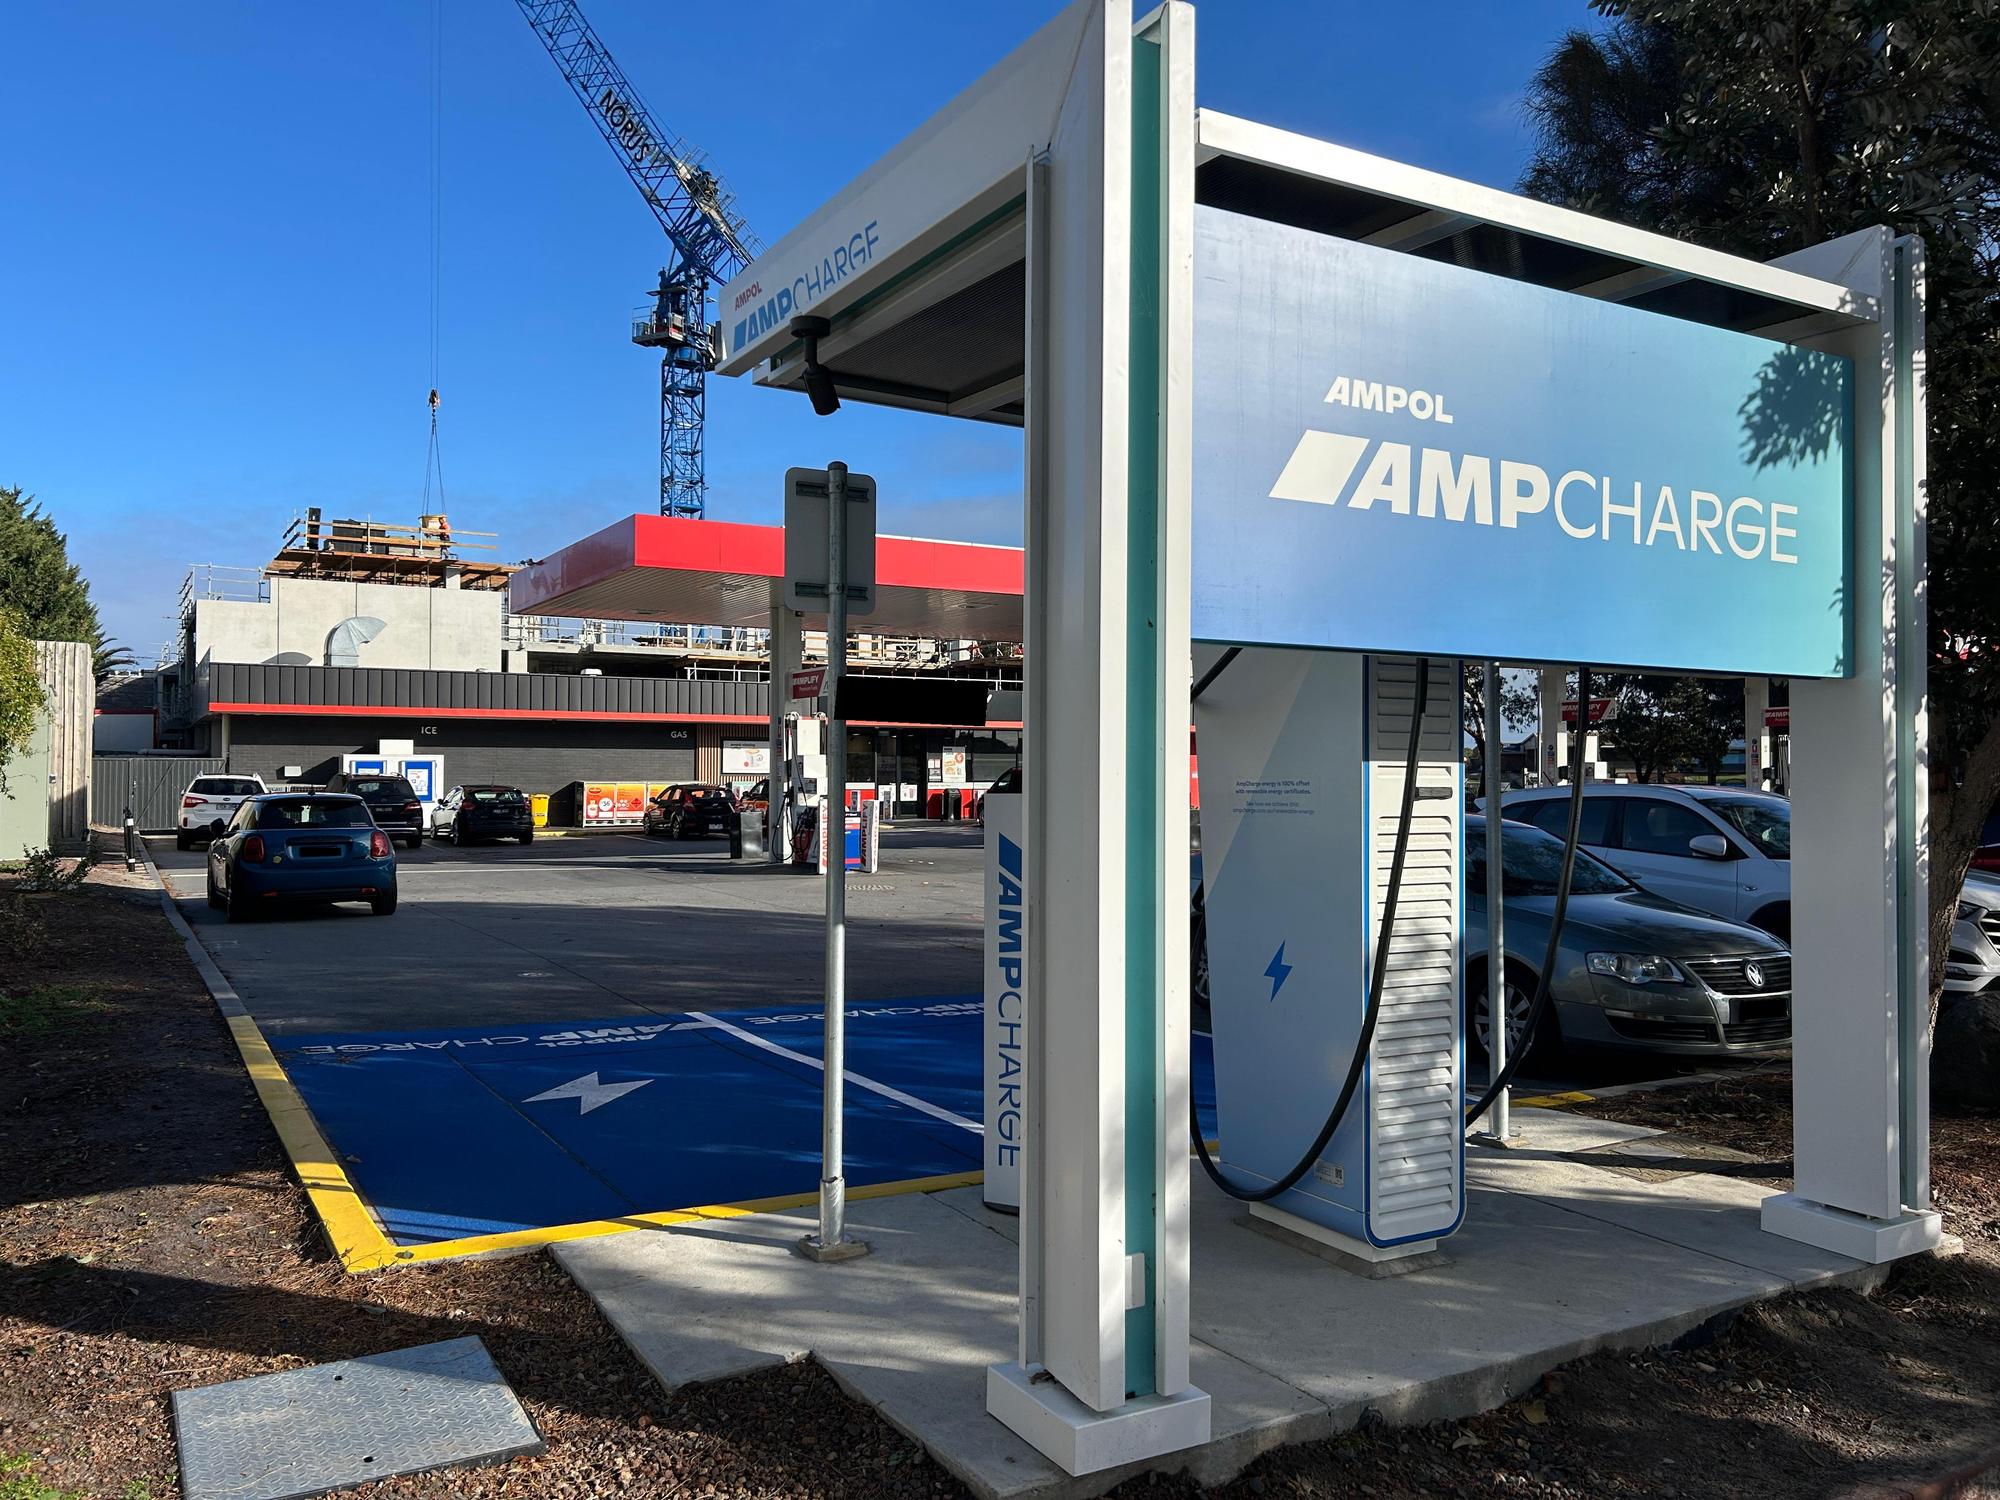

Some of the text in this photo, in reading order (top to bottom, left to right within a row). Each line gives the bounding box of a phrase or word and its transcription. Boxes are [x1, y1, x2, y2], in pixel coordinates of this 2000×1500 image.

[734, 281, 762, 311] AMPOL
[1323, 376, 1454, 424] AMPOL
[1347, 440, 1799, 565] AMPCHARGE
[1565, 703, 1601, 711] AMIFY
[421, 726, 438, 734] ICE
[997, 876, 1023, 1167] AMPCHARGE
[535, 1032, 659, 1048] AMPOL
